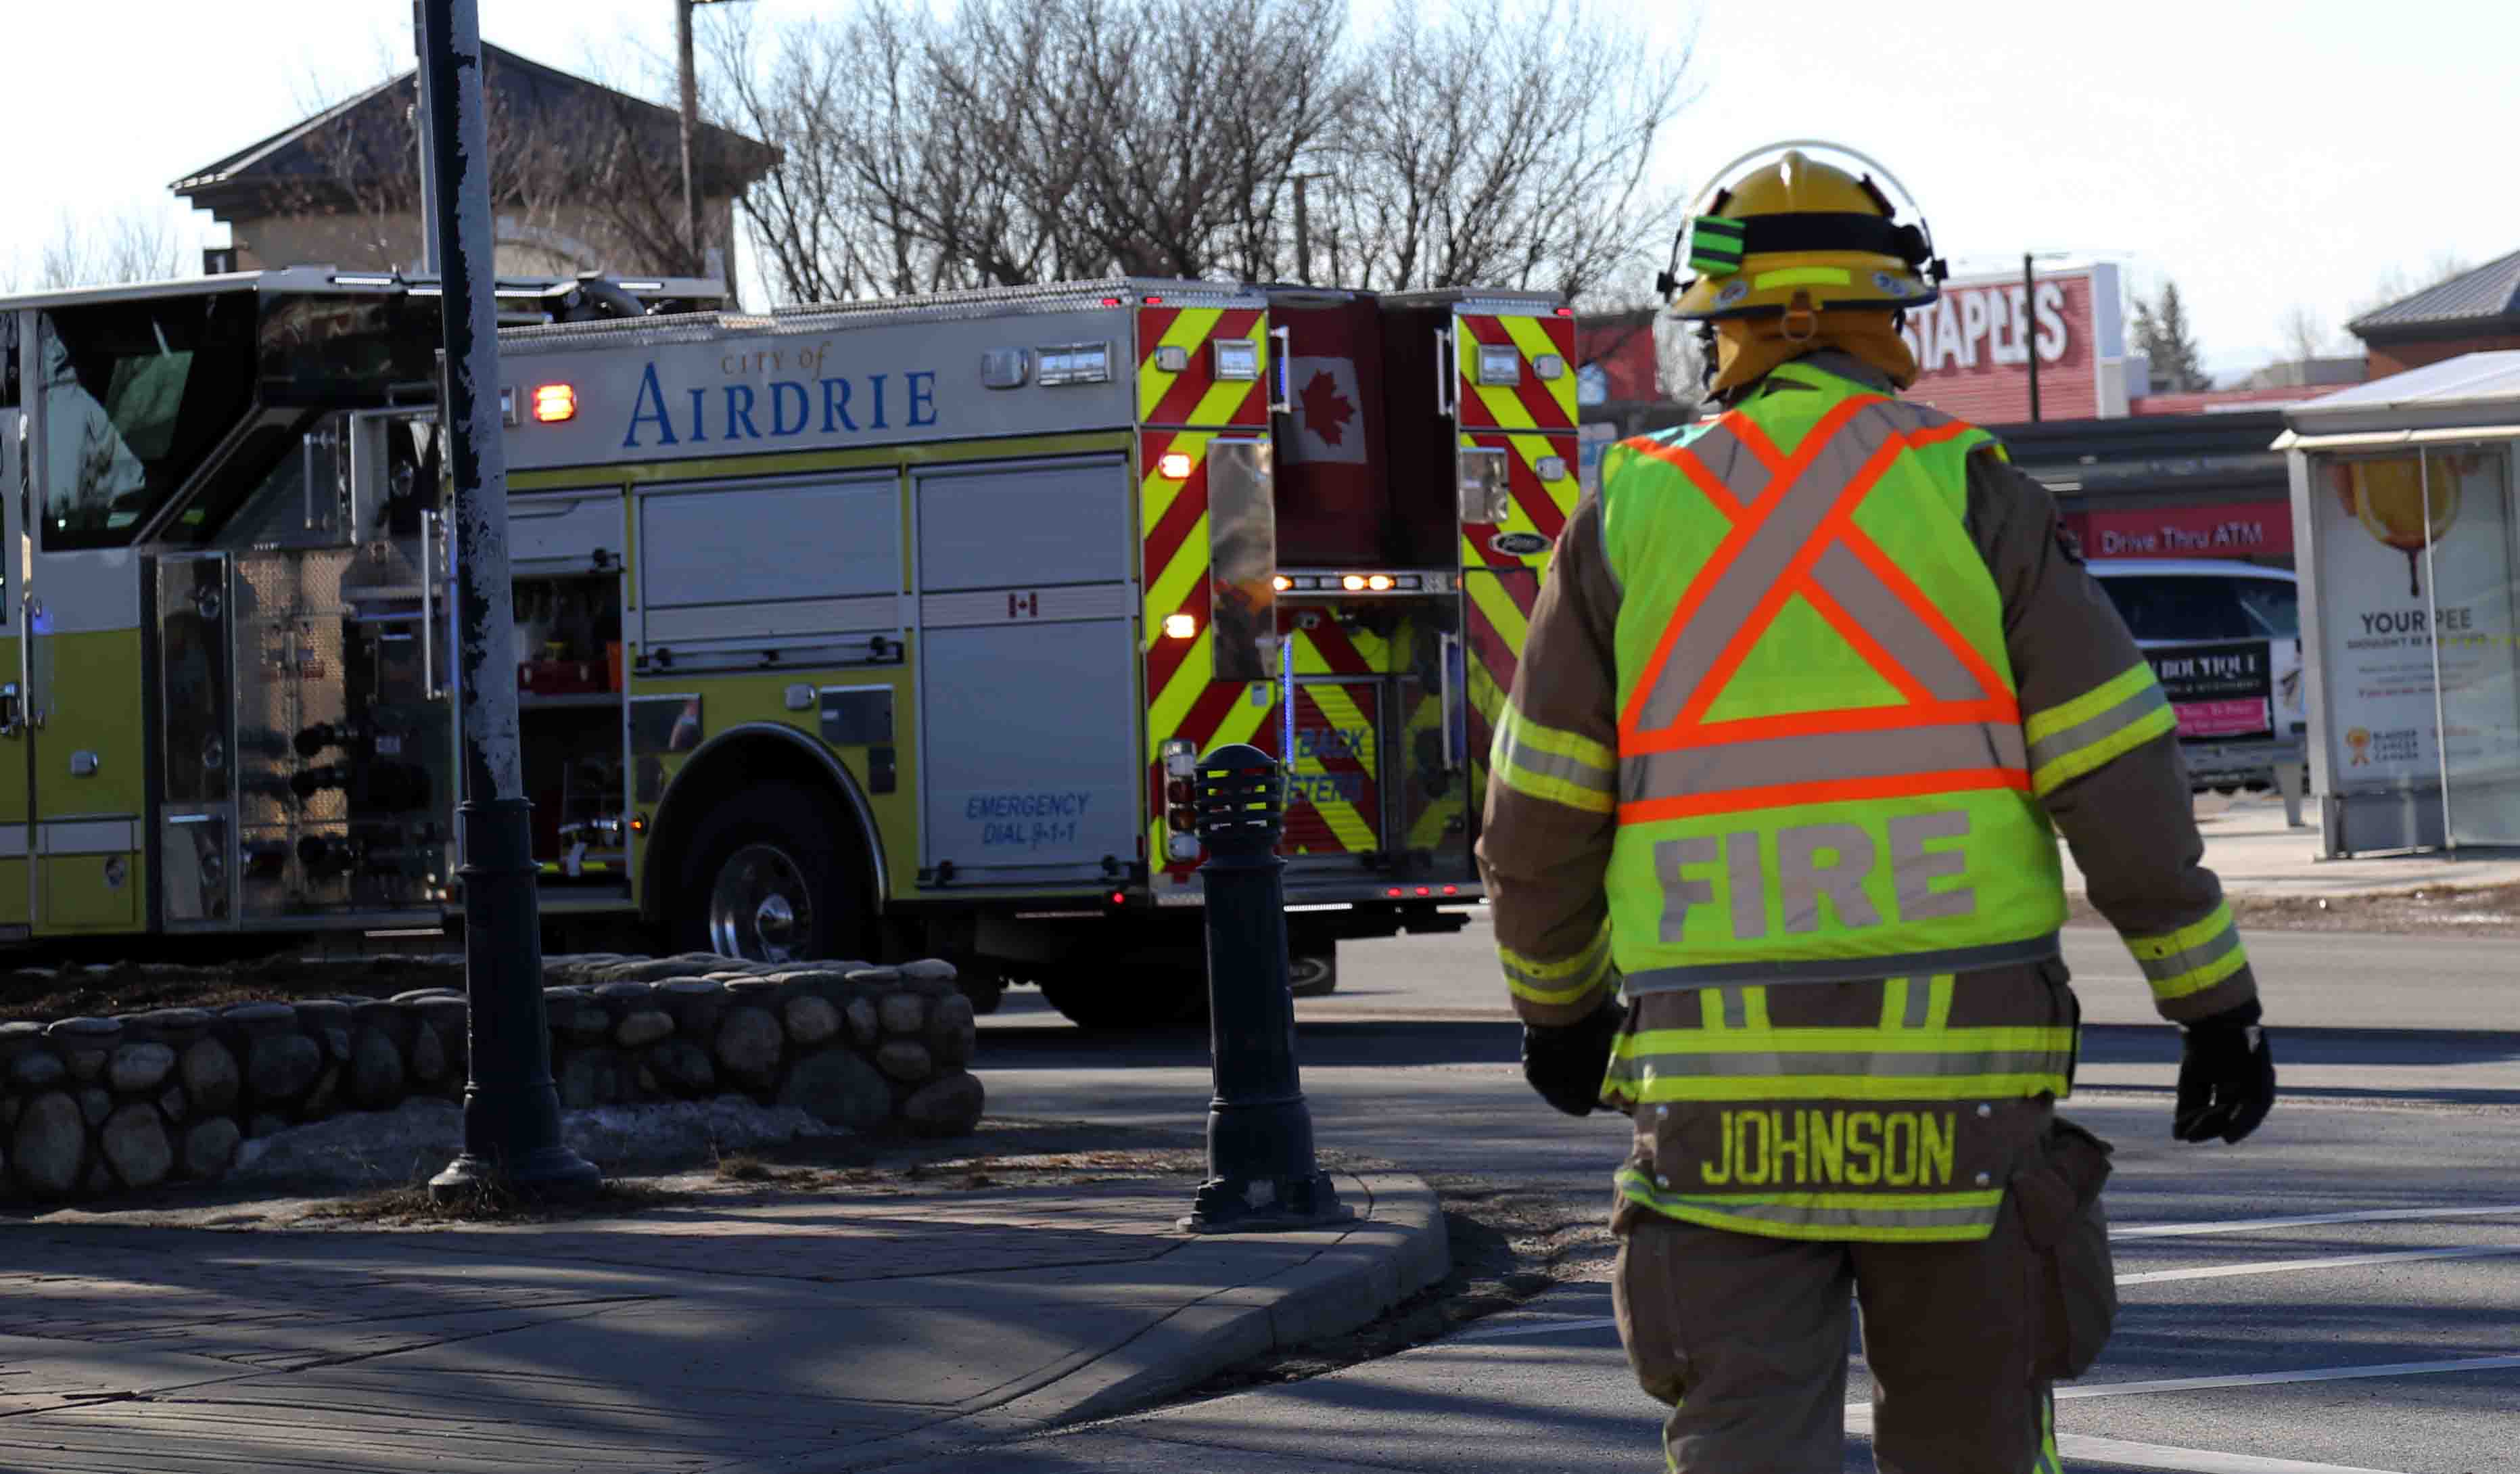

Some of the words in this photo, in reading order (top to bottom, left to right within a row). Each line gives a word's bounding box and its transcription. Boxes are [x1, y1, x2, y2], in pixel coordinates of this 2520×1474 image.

[721, 350, 785, 375] CITY
[799, 340, 832, 382] of
[622, 360, 939, 448] AIRDRIE
[2101, 530, 2155, 555] Drive
[2160, 526, 2210, 550] Thru
[2214, 521, 2263, 547] ATM
[2361, 609, 2427, 635] YOUR
[1299, 727, 1367, 758] BACK
[967, 791, 1092, 820] EMERGENCY
[985, 822, 1025, 845] DIAL
[1653, 808, 1978, 944] FIRE
[1700, 1109, 1957, 1187] JOHNSON
